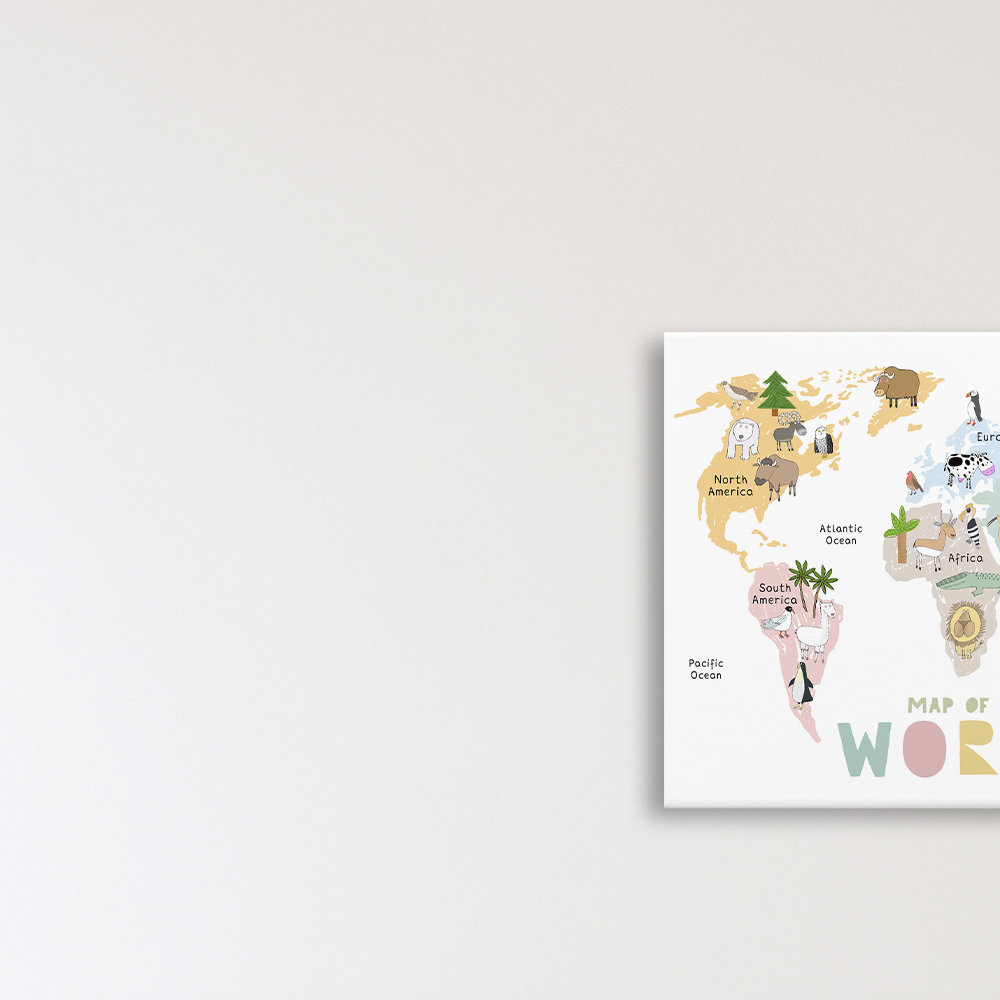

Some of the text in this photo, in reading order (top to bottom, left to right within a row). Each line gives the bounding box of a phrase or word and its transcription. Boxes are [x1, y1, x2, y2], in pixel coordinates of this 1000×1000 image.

[713, 474, 748, 485] North
[707, 485, 754, 497] America
[819, 523, 863, 533] Atlantic
[825, 535, 857, 545] Ocean
[947, 552, 984, 564] Africa
[758, 582, 792, 593] South
[751, 594, 798, 605] America
[688, 658, 724, 670] Pacific
[690, 670, 722, 680] Ocean
[907, 697, 954, 714] MAP
[965, 697, 989, 714] OF
